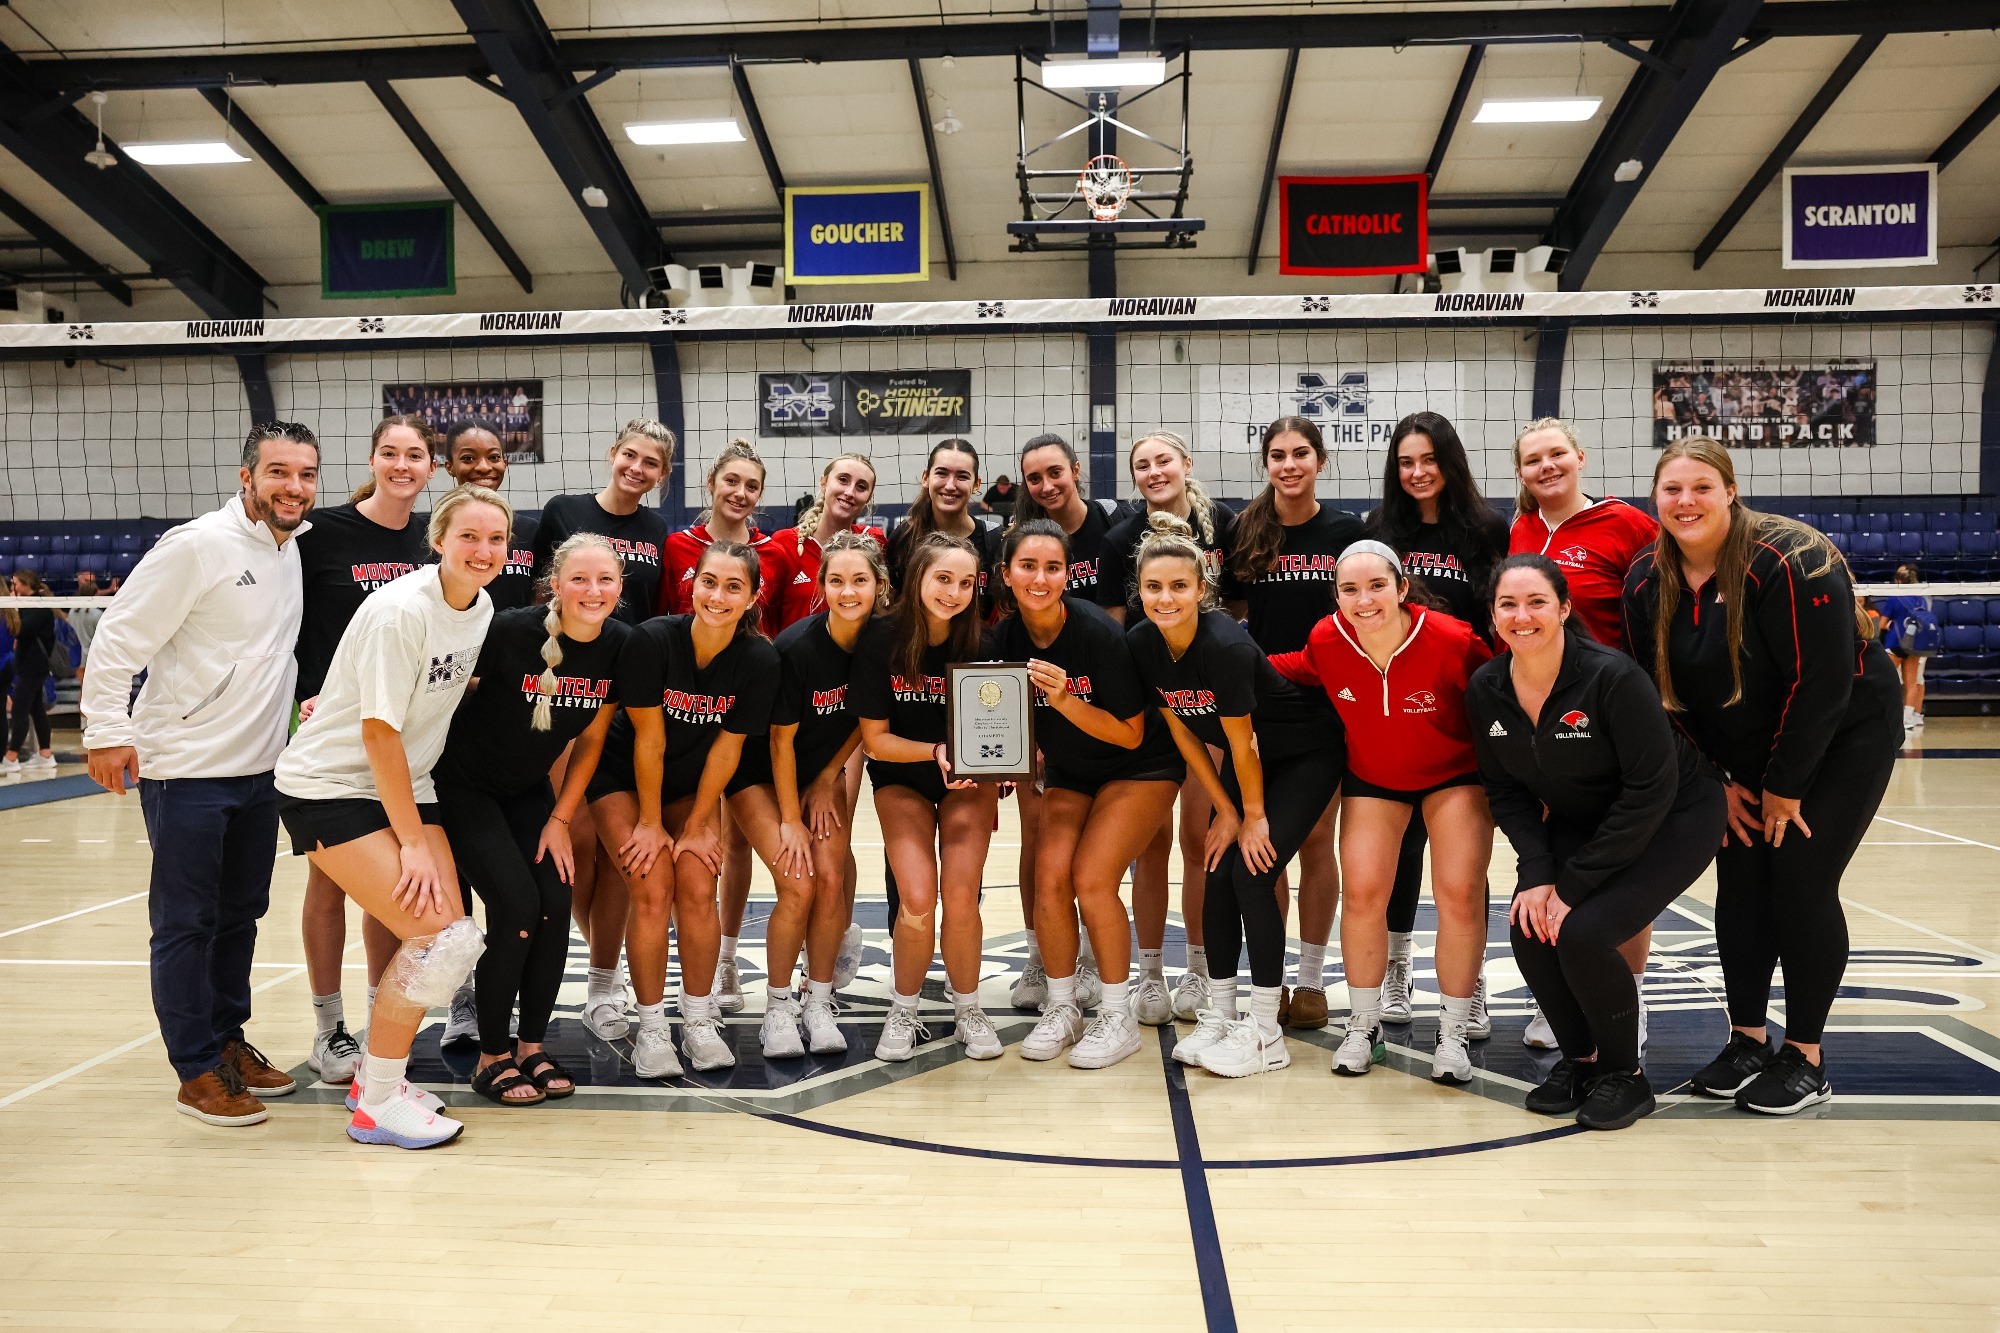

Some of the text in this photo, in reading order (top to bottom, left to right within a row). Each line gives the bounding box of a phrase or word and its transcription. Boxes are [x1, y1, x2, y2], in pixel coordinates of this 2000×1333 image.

[1306, 213, 1403, 235] CATHOLIC
[1804, 203, 1916, 227] SCRANTON
[810, 222, 904, 245] GOUCHER
[361, 239, 415, 259] DREW
[1434, 293, 1525, 312] MORAVIAN
[1764, 288, 1856, 307] MORAVIAN
[787, 304, 874, 323] MORAVIAN
[1108, 298, 1198, 317] MORAVIAN
[186, 320, 265, 338] MORAVIAN
[479, 312, 563, 331] MORAVIAN
[885, 388, 943, 398] HONEY
[880, 396, 964, 418] STINGER
[1331, 424, 1364, 443] THE
[1371, 424, 1393, 443] PA
[1666, 423, 1855, 441] HOUND PACK
[1279, 554, 1336, 572] TCLAIR
[1404, 566, 1469, 583] LEYBALL
[1402, 706, 1437, 714] VOLLEYBALL
[1554, 731, 1592, 740] VOLLEYBALL
